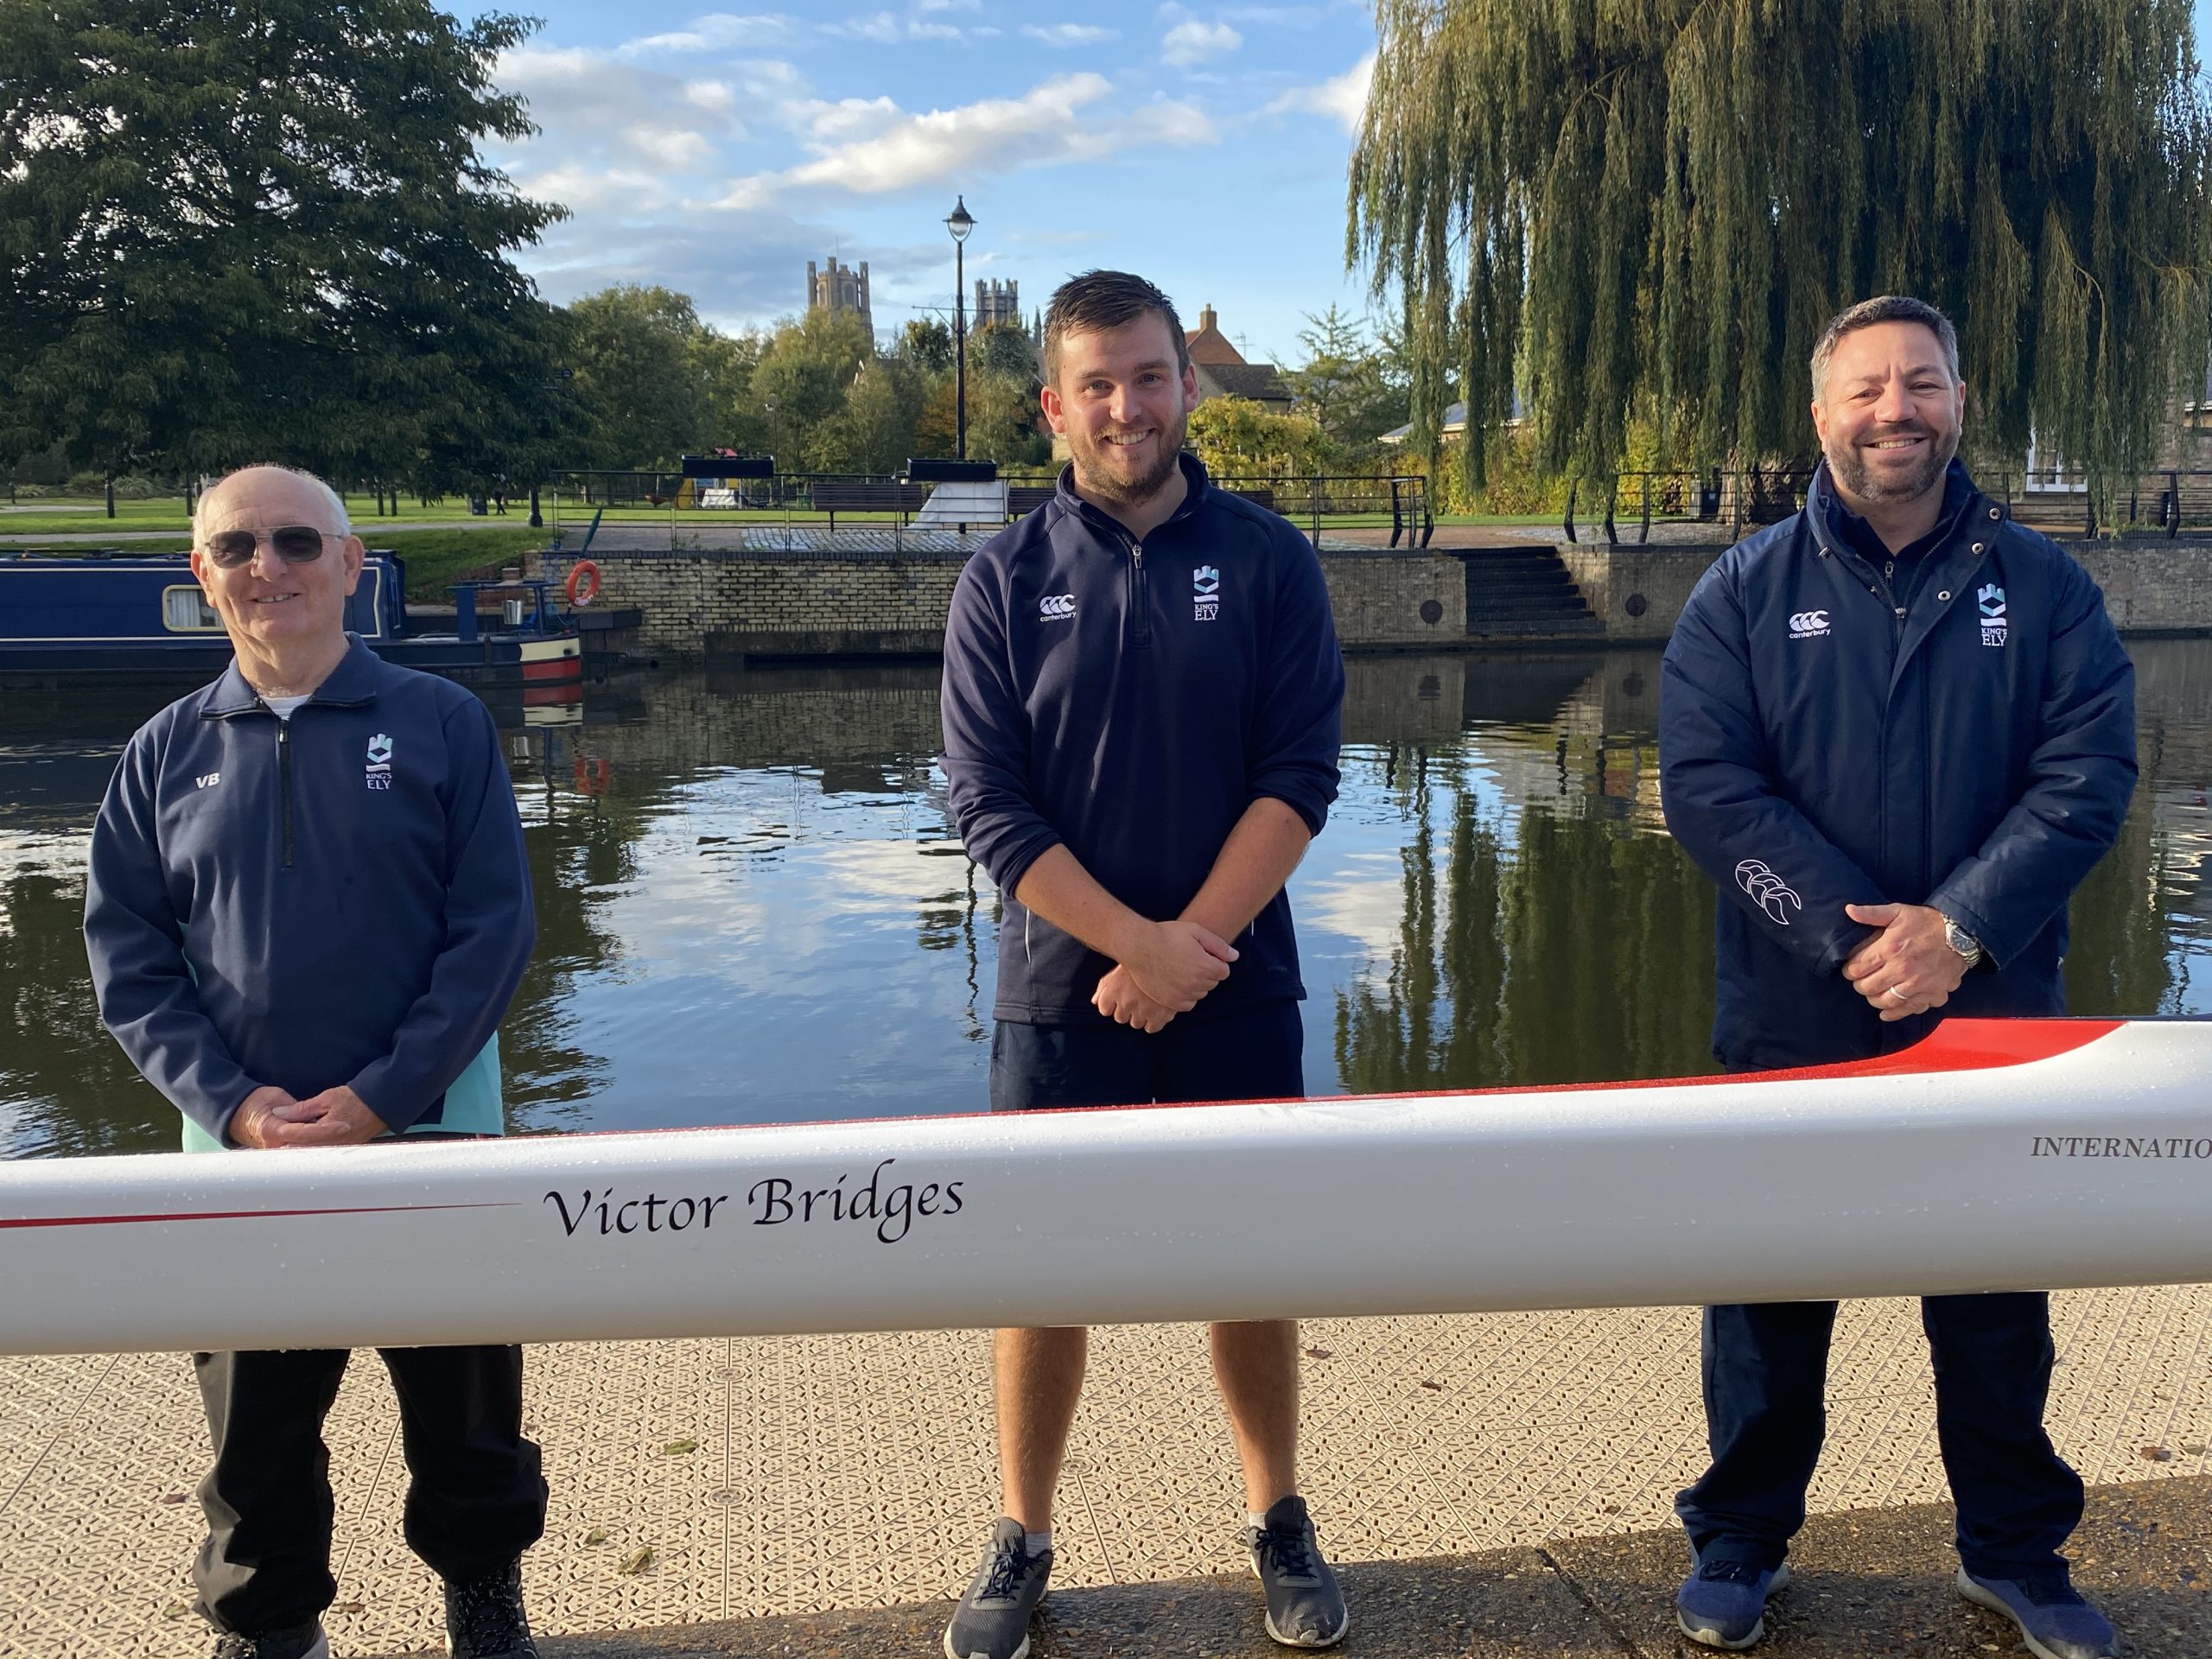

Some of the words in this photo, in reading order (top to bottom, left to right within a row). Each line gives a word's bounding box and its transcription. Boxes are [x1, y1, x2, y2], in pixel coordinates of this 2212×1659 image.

[1039, 610, 1077, 622] canterbury
[1194, 609, 1218, 620] ELY
[1789, 628, 1831, 639] canterbury
[1982, 634, 2006, 646] ELY
[195, 772, 219, 789] VB
[366, 779, 391, 790] ELY
[2031, 1136, 2212, 1159] INTERNATIO
[543, 1187, 728, 1237] Victor
[747, 1158, 965, 1244] Bridges
